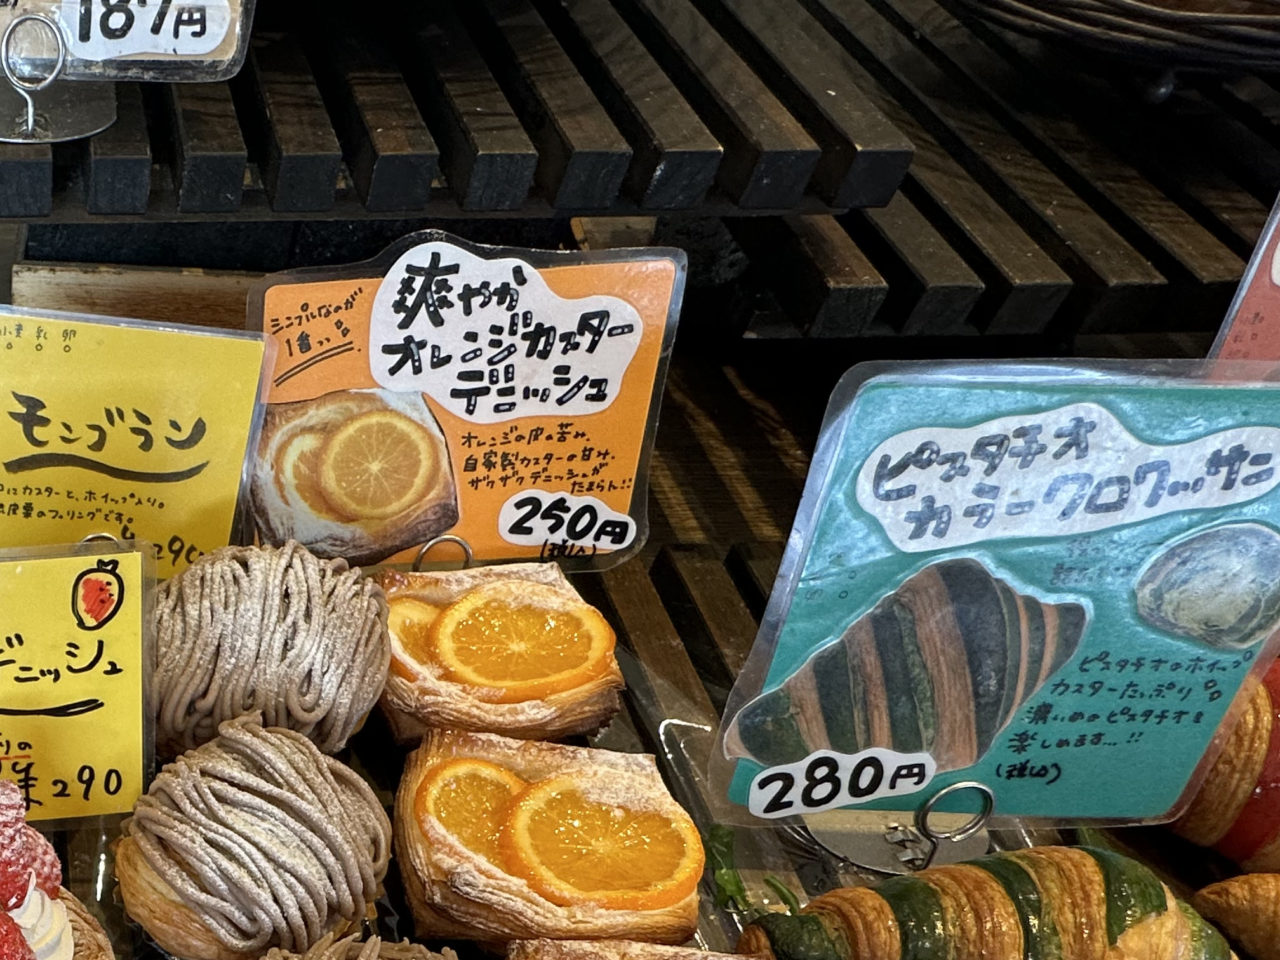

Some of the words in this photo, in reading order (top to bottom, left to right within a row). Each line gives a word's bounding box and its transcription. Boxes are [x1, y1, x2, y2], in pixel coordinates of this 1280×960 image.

[392, 252, 527, 330] 爽やか
[381, 310, 634, 376] オレンジカスター
[7, 390, 207, 452] モンブラン
[450, 364, 608, 415] デニッシュ
[873, 416, 1097, 501] ピスタチオ
[508, 497, 629, 544] 250円
[904, 443, 1274, 540] カラークロワッサン
[758, 756, 926, 814] 280円
